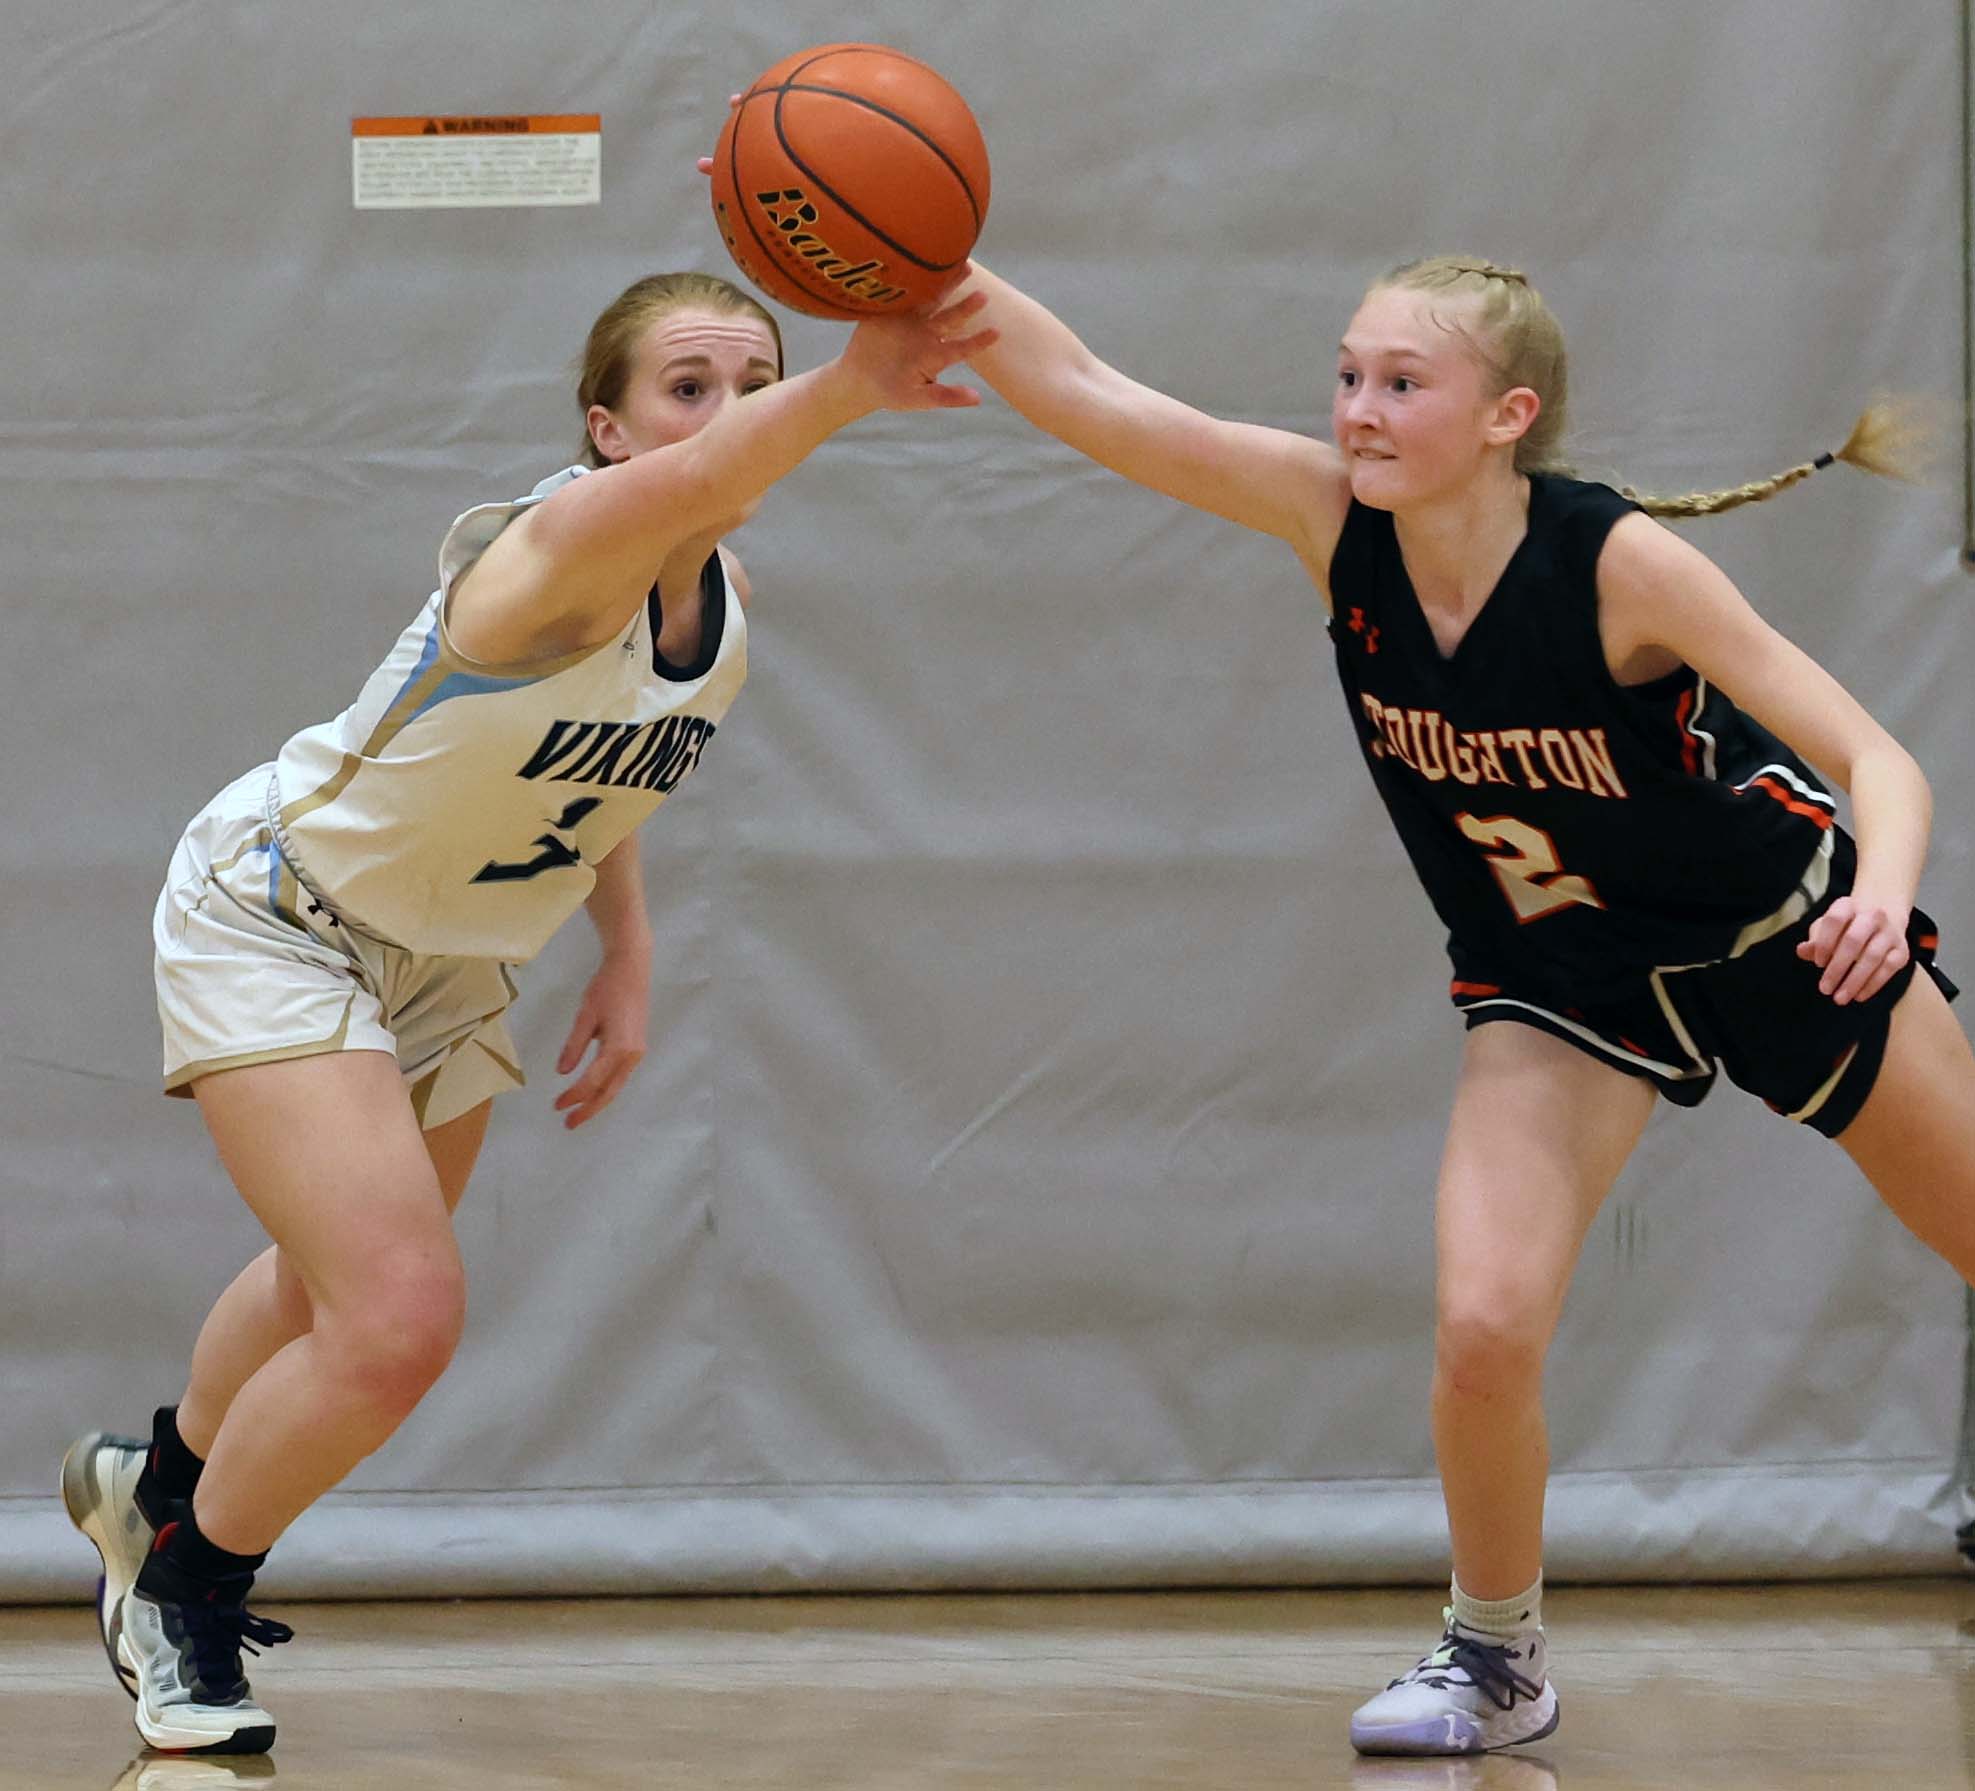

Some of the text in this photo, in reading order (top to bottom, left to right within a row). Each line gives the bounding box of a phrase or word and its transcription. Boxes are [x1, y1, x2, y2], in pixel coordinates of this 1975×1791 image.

[442, 117, 529, 134] WARNING
[756, 188, 908, 303] Baden
[1454, 811, 1609, 926] 2
